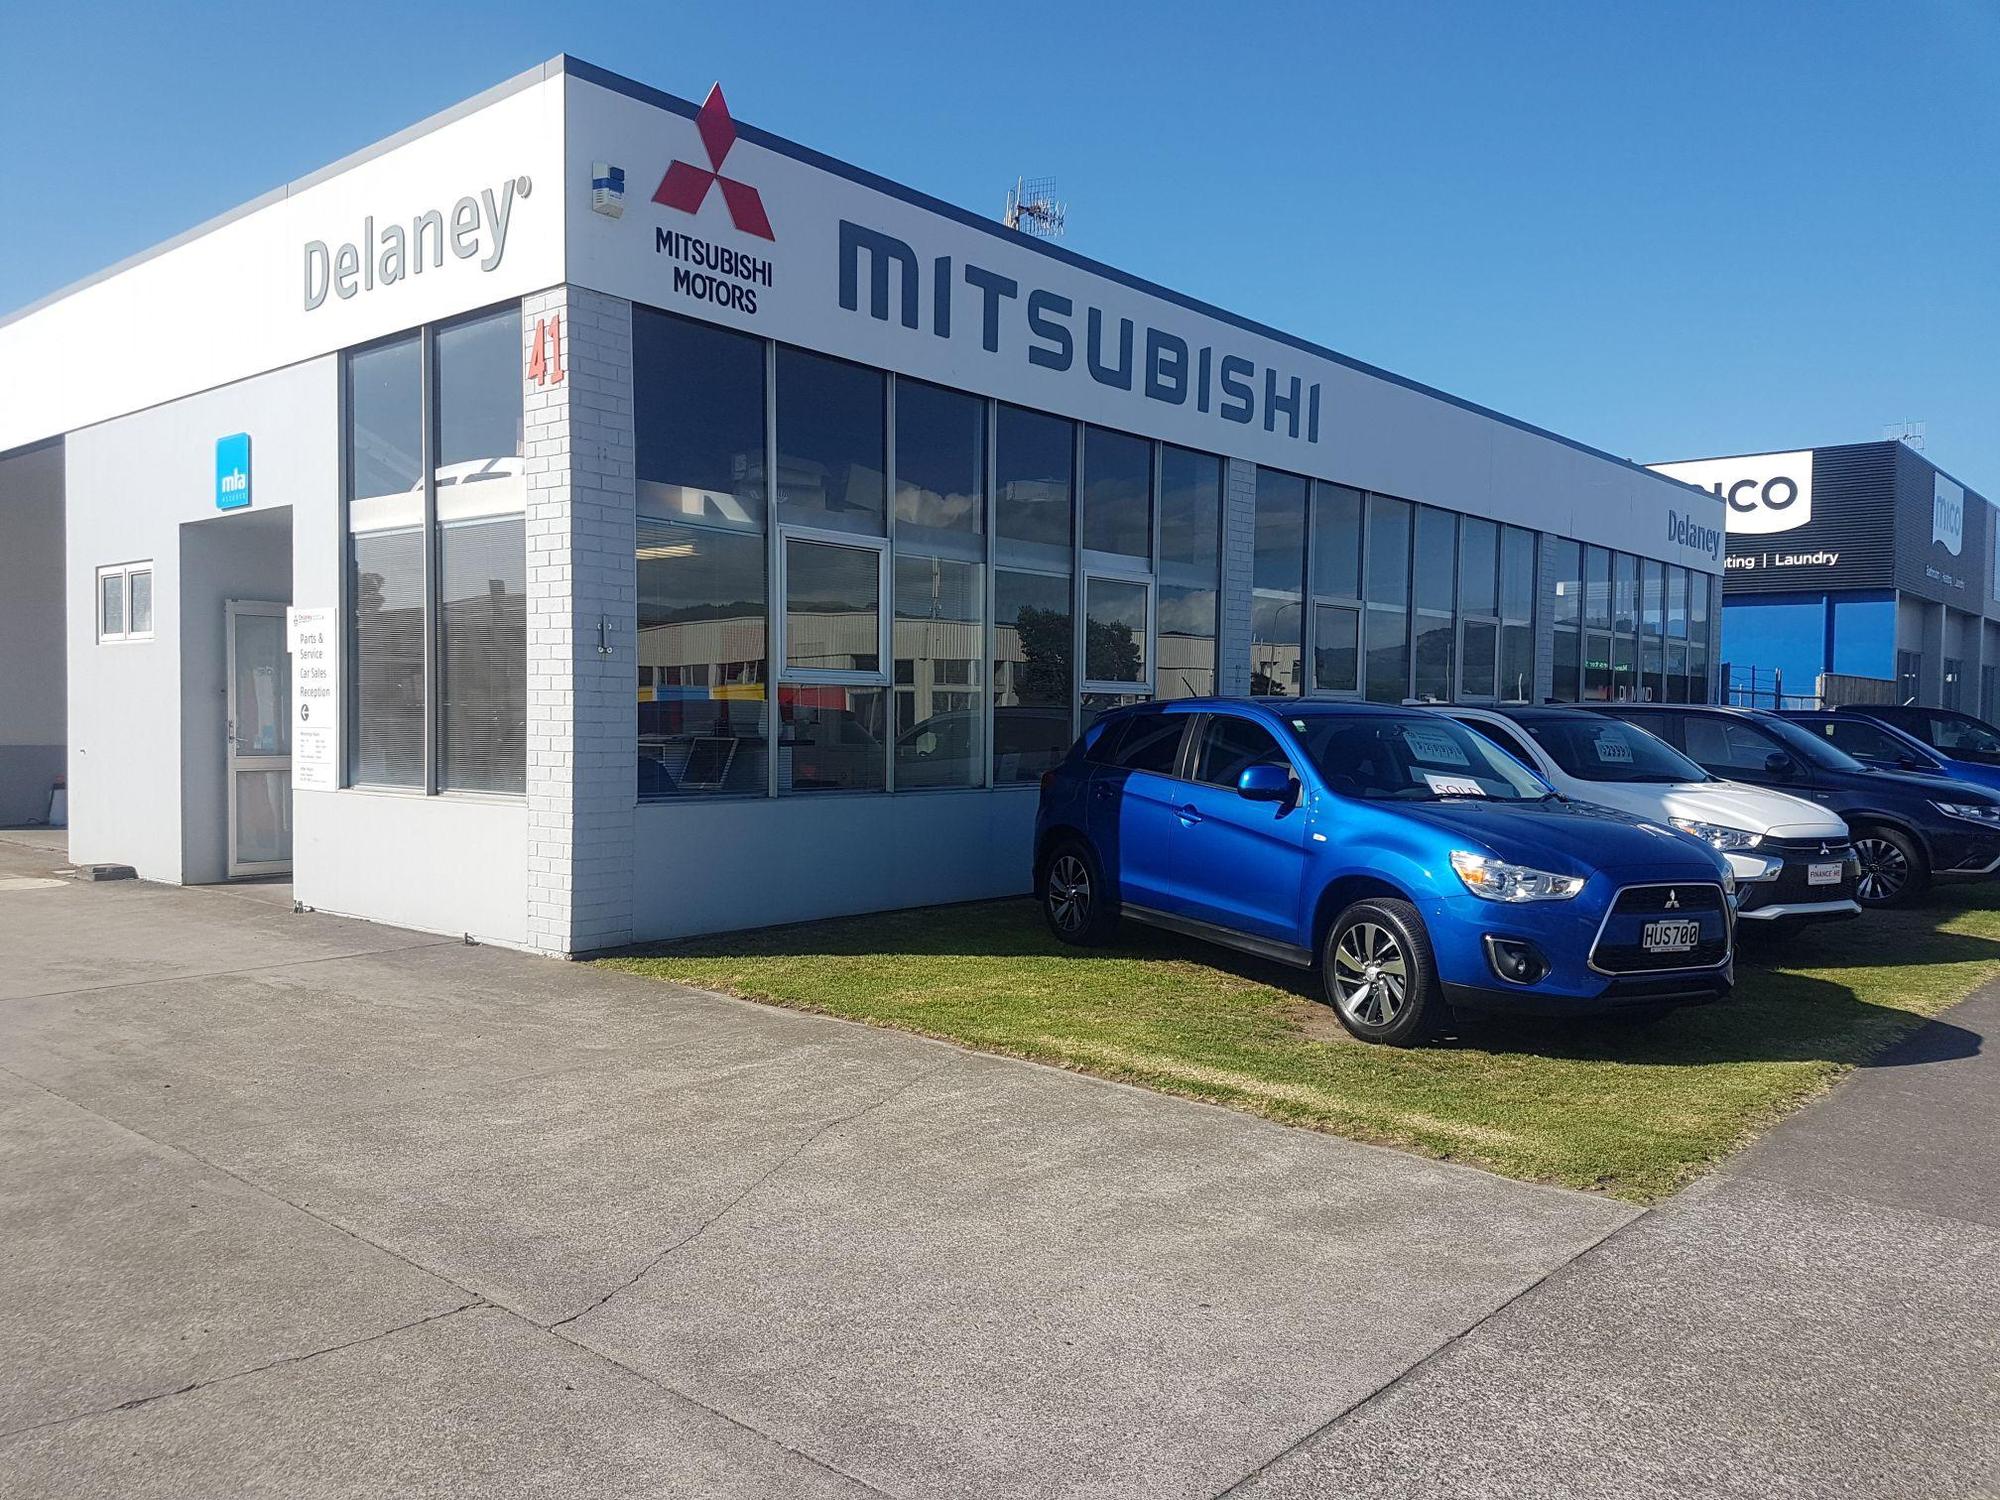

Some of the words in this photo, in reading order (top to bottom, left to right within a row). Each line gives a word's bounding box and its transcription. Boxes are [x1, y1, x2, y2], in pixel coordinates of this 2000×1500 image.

[304, 179, 516, 312] Delaney
[656, 226, 772, 288] MITSUBISHI
[673, 266, 757, 314] MOTORS
[838, 218, 1321, 444] MITSUBISHI
[527, 313, 565, 387] 41
[1668, 510, 1720, 561] Delaney
[1775, 551, 1839, 566] Laundry
[300, 632, 317, 644] Parts
[318, 632, 324, 643] &
[300, 648, 323, 659] Service
[300, 668, 309, 678] Car
[311, 667, 327, 678] Sales
[300, 687, 331, 698] Reception
[1645, 926, 1698, 946] HUS700
